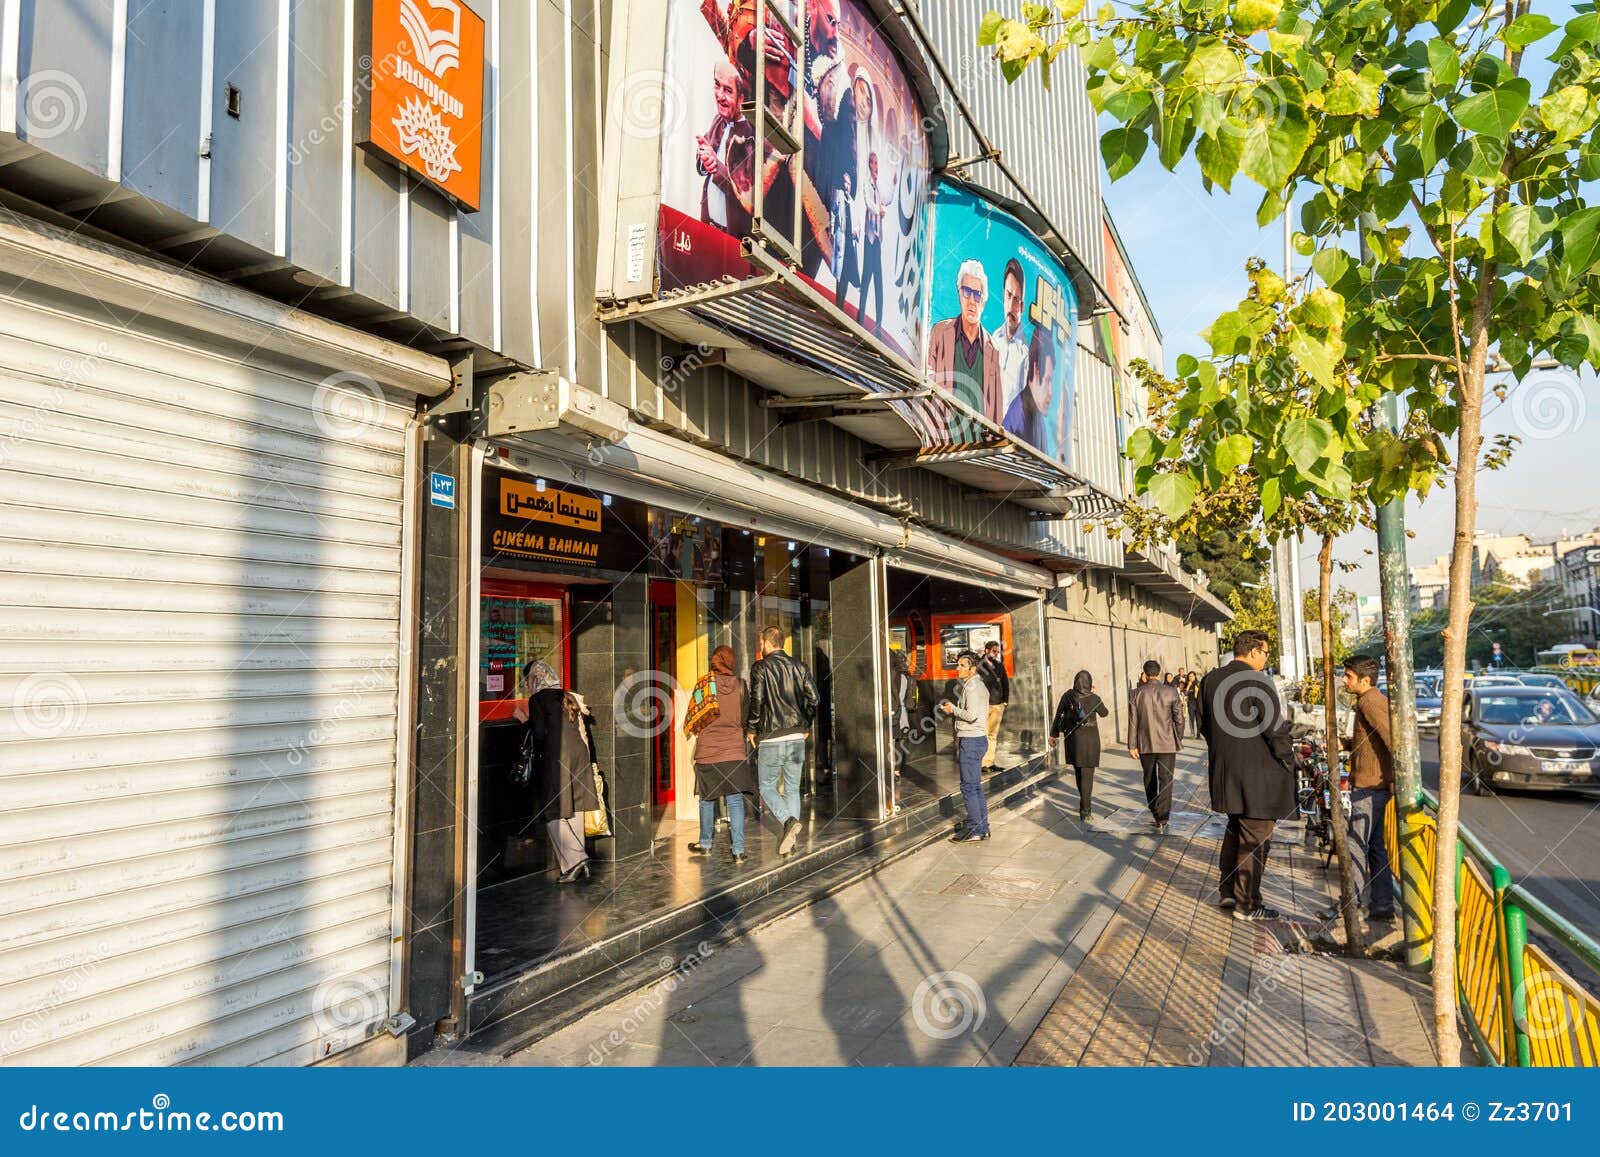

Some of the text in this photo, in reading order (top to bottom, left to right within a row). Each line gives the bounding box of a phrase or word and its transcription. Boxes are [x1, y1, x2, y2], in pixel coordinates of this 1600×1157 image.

[507, 493, 598, 524] سینما بهمن
[493, 530, 599, 557] CINEMA BAHMAN
